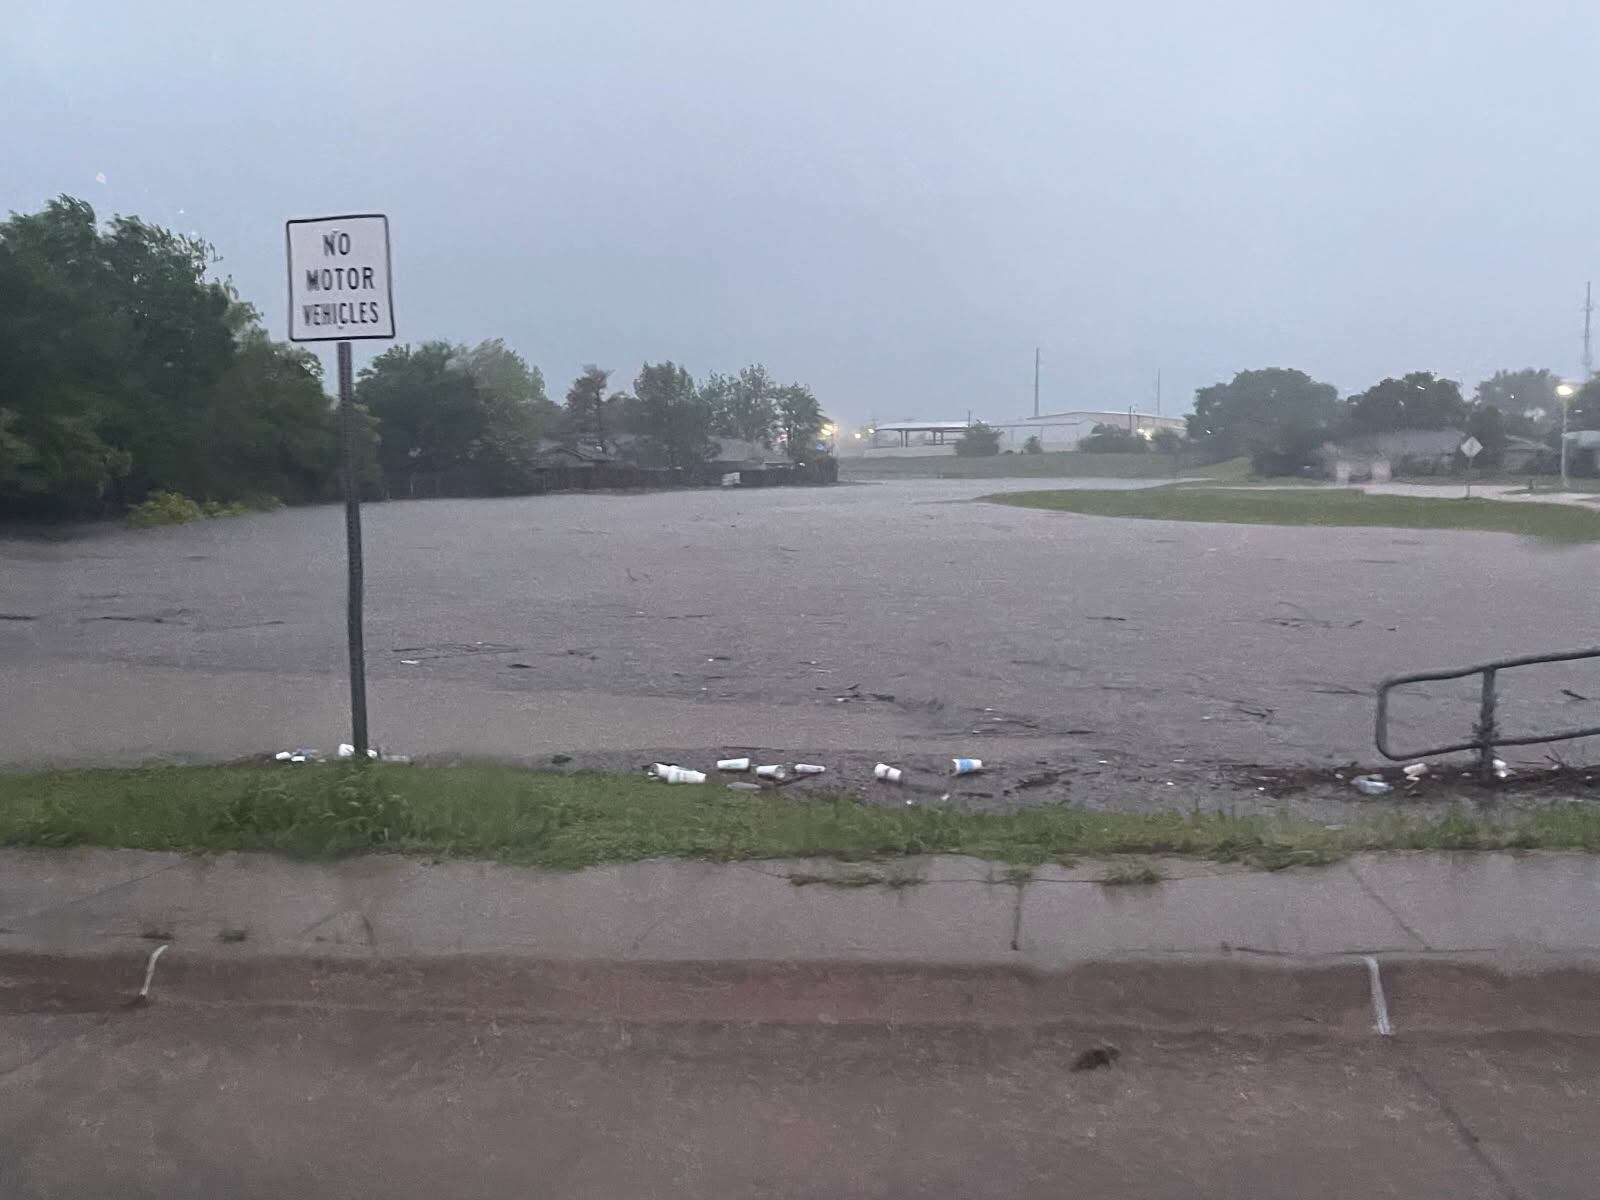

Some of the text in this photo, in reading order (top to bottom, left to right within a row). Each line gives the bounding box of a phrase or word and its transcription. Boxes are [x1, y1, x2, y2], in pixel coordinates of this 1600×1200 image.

[323, 232, 351, 256] NO
[305, 266, 375, 291] MOTOR
[303, 301, 379, 326] VEHICLES
